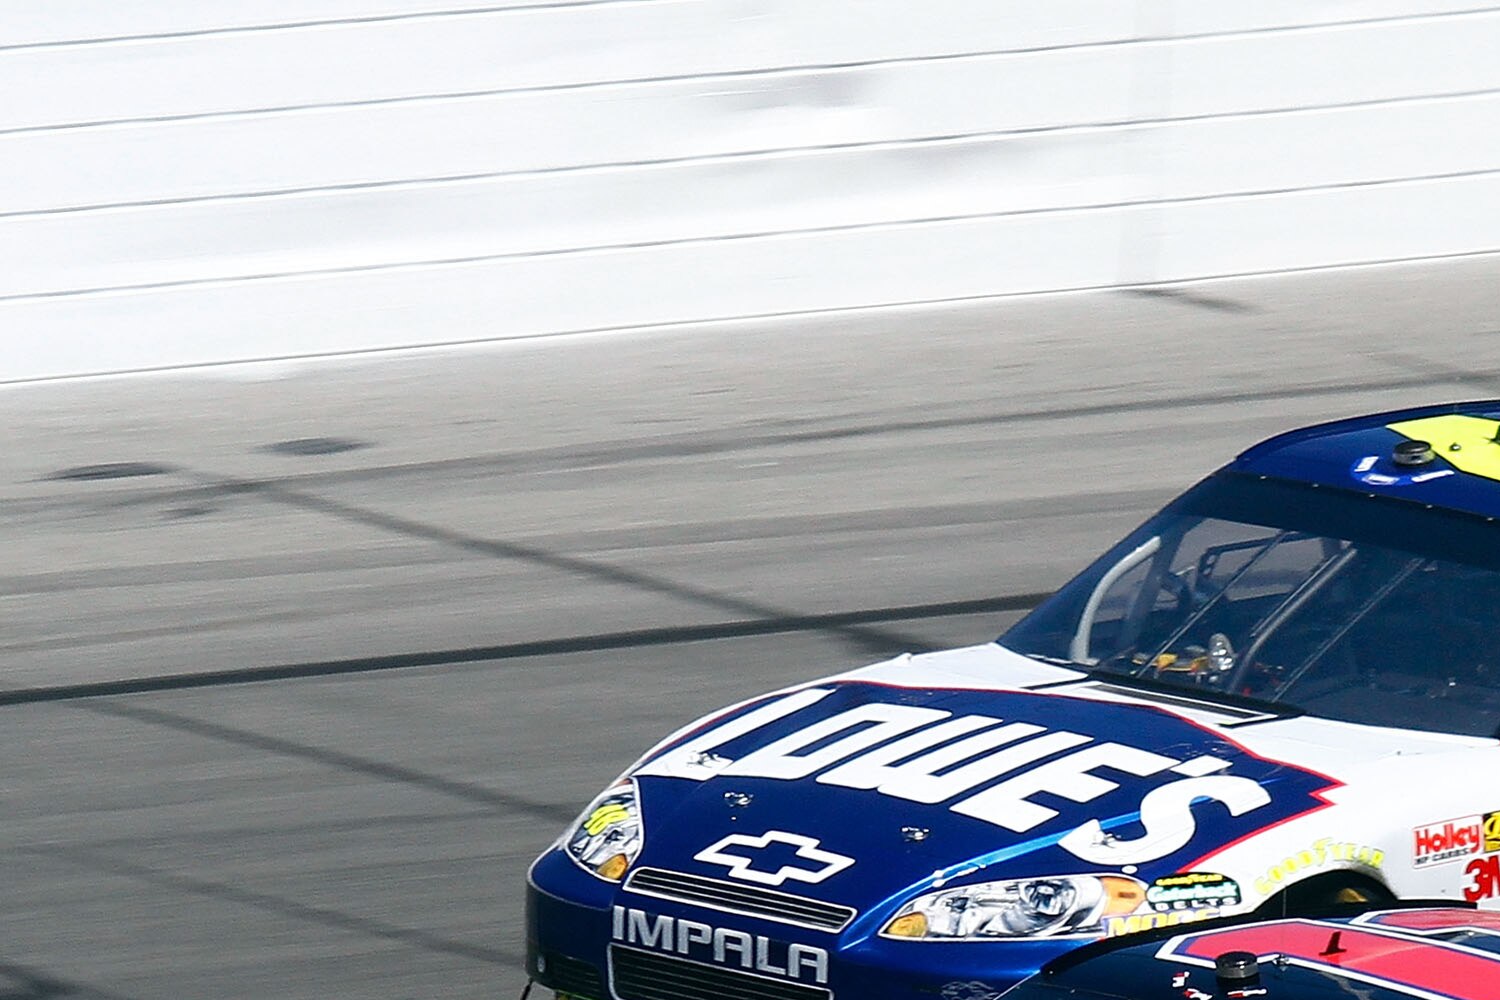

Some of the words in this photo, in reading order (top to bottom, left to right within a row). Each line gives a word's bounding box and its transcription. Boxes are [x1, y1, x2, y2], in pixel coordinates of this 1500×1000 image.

[628, 688, 1273, 865] LOWE'S
[1414, 823, 1480, 856] Holley
[612, 905, 829, 985] IMPALA
